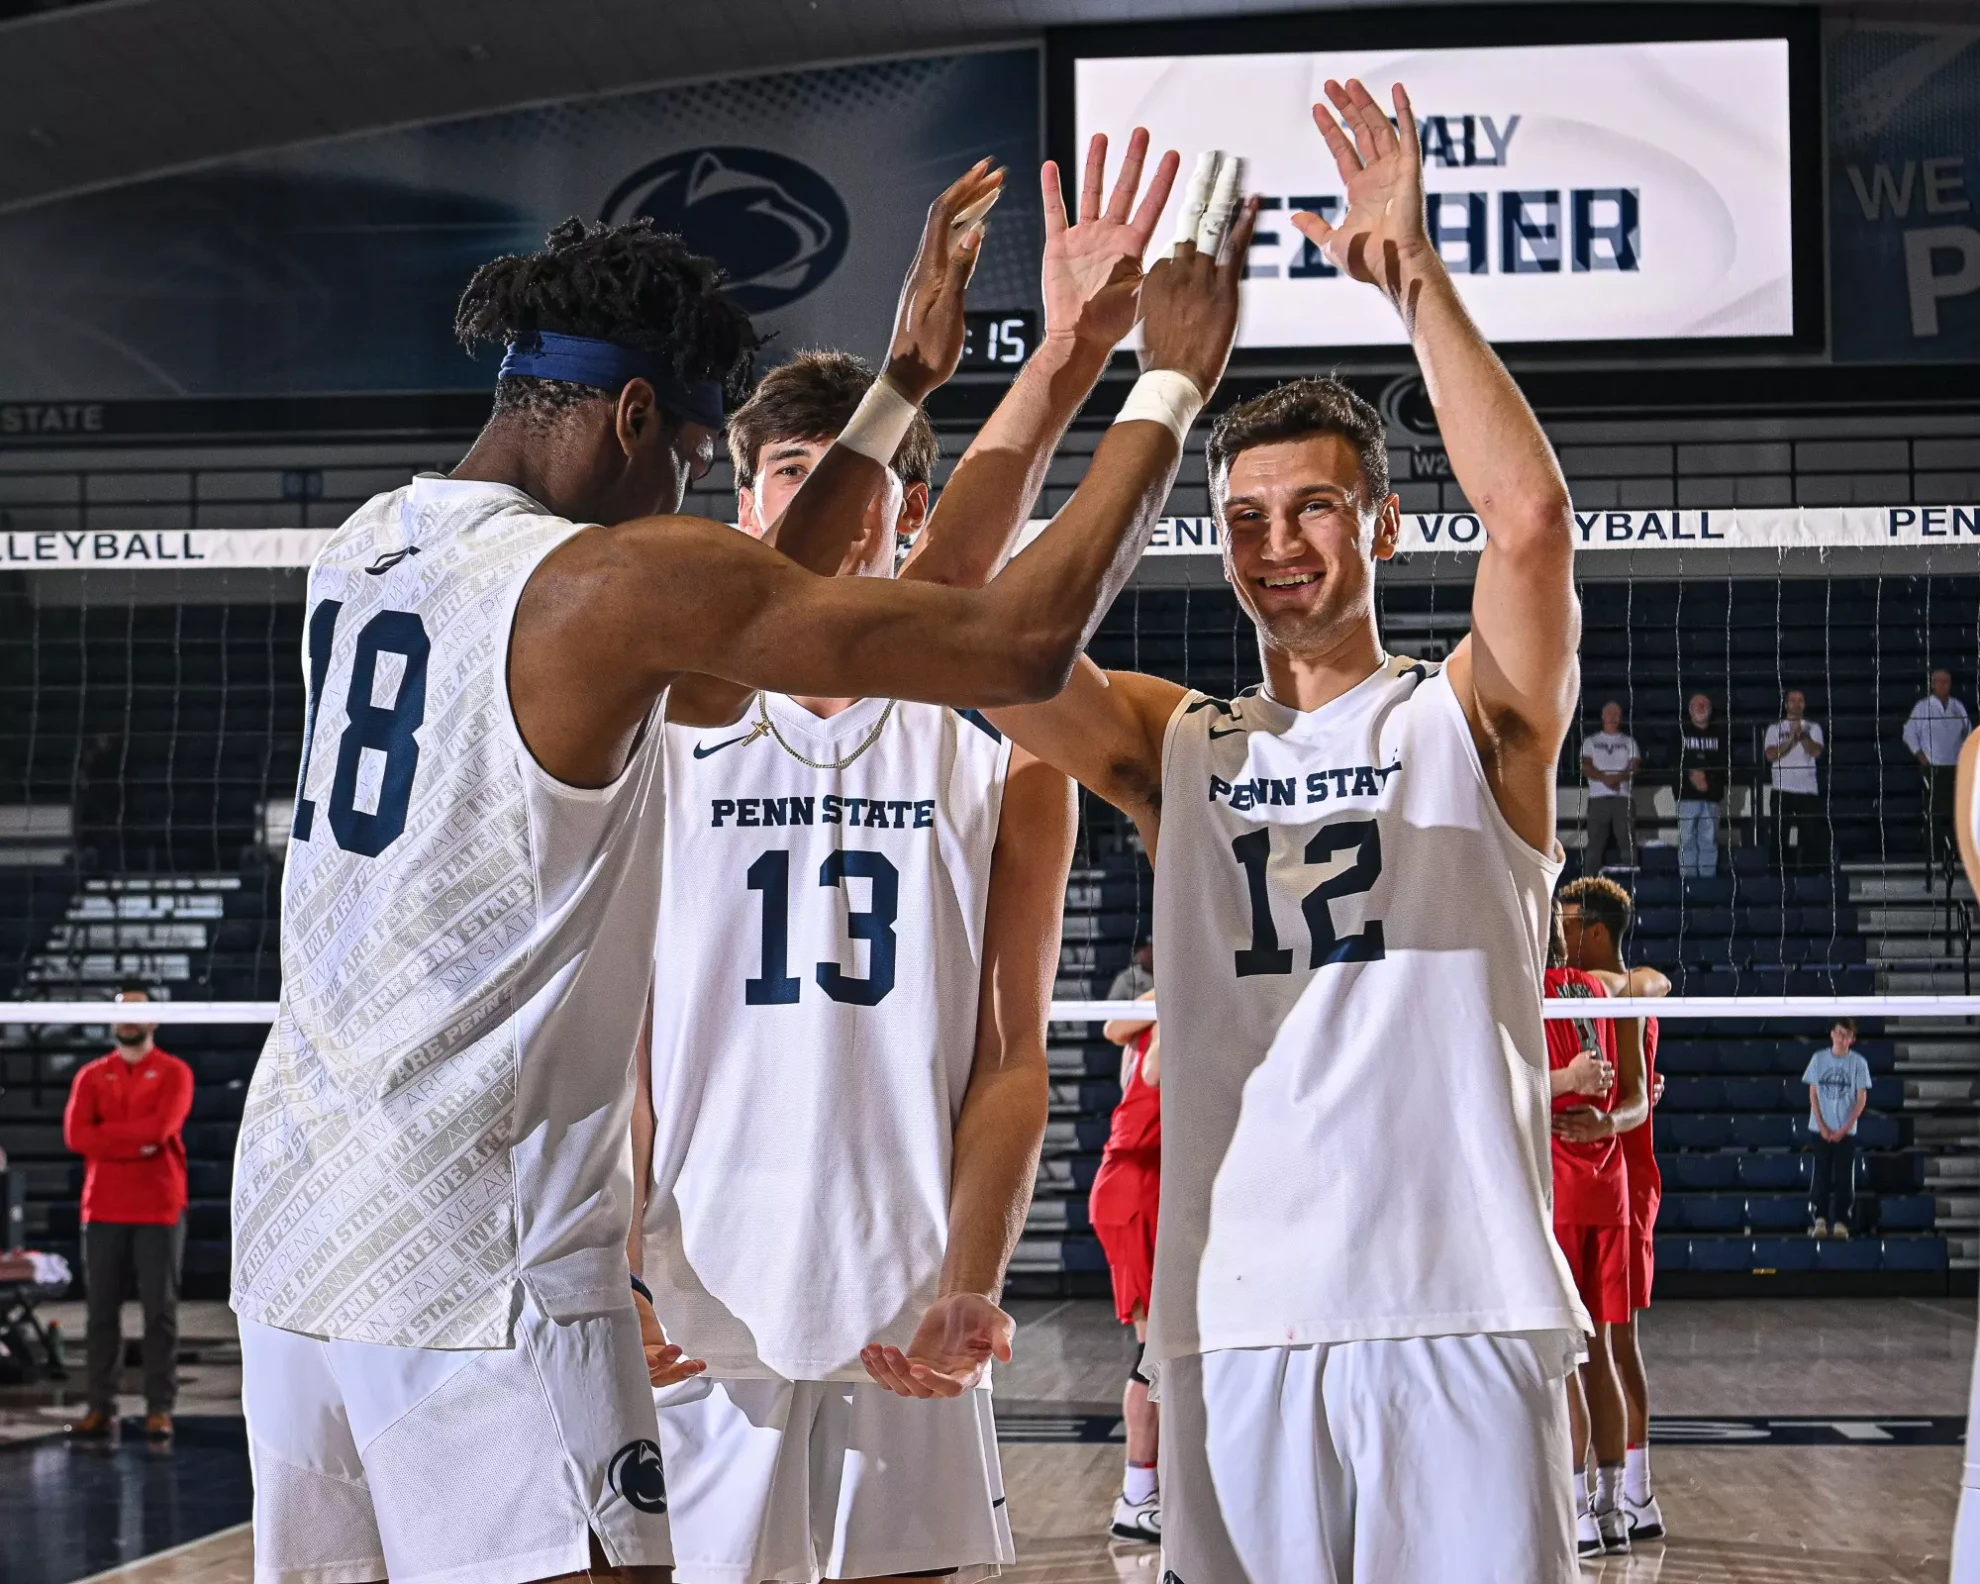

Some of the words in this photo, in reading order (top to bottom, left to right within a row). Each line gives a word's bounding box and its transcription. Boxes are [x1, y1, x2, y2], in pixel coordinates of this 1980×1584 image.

[1847, 157, 1971, 221] WE
[3, 405, 103, 432] STATE
[0, 533, 204, 561] LEYBALL
[291, 598, 431, 858] 18
[711, 797, 815, 827] PENN
[822, 795, 935, 829] STATE
[1209, 774, 1297, 811] PENN
[1307, 758, 1402, 804] STAT
[341, 933, 376, 980] ARE
[426, 831, 495, 893] STATE
[446, 852, 515, 911] STATE
[1231, 819, 1385, 977] 12
[363, 977, 407, 1024] ARE
[406, 930, 464, 985] PENN
[461, 876, 532, 938] STATE
[745, 849, 899, 1006] 13
[394, 1038, 444, 1084] ARE
[382, 1122, 428, 1164] WE
[399, 1142, 445, 1180] WE
[447, 1100, 493, 1150] ARE
[422, 1163, 468, 1205] WE
[464, 1120, 509, 1171] ARE
[245, 1237, 271, 1281] ARE
[269, 1192, 310, 1245] PENN
[306, 1141, 365, 1200] STATE
[278, 1220, 319, 1275] PENN
[320, 1164, 377, 1226] STATE
[437, 1192, 481, 1231] WE
[265, 1282, 297, 1325] ARE
[295, 1236, 340, 1289] PENN
[336, 1183, 400, 1245] STATE
[308, 1262, 356, 1316] PENN
[353, 1206, 419, 1267] STATE
[323, 1286, 374, 1338] PENN
[371, 1230, 438, 1294] STATE
[389, 1254, 457, 1318] STATE
[410, 1271, 480, 1335] STATE
